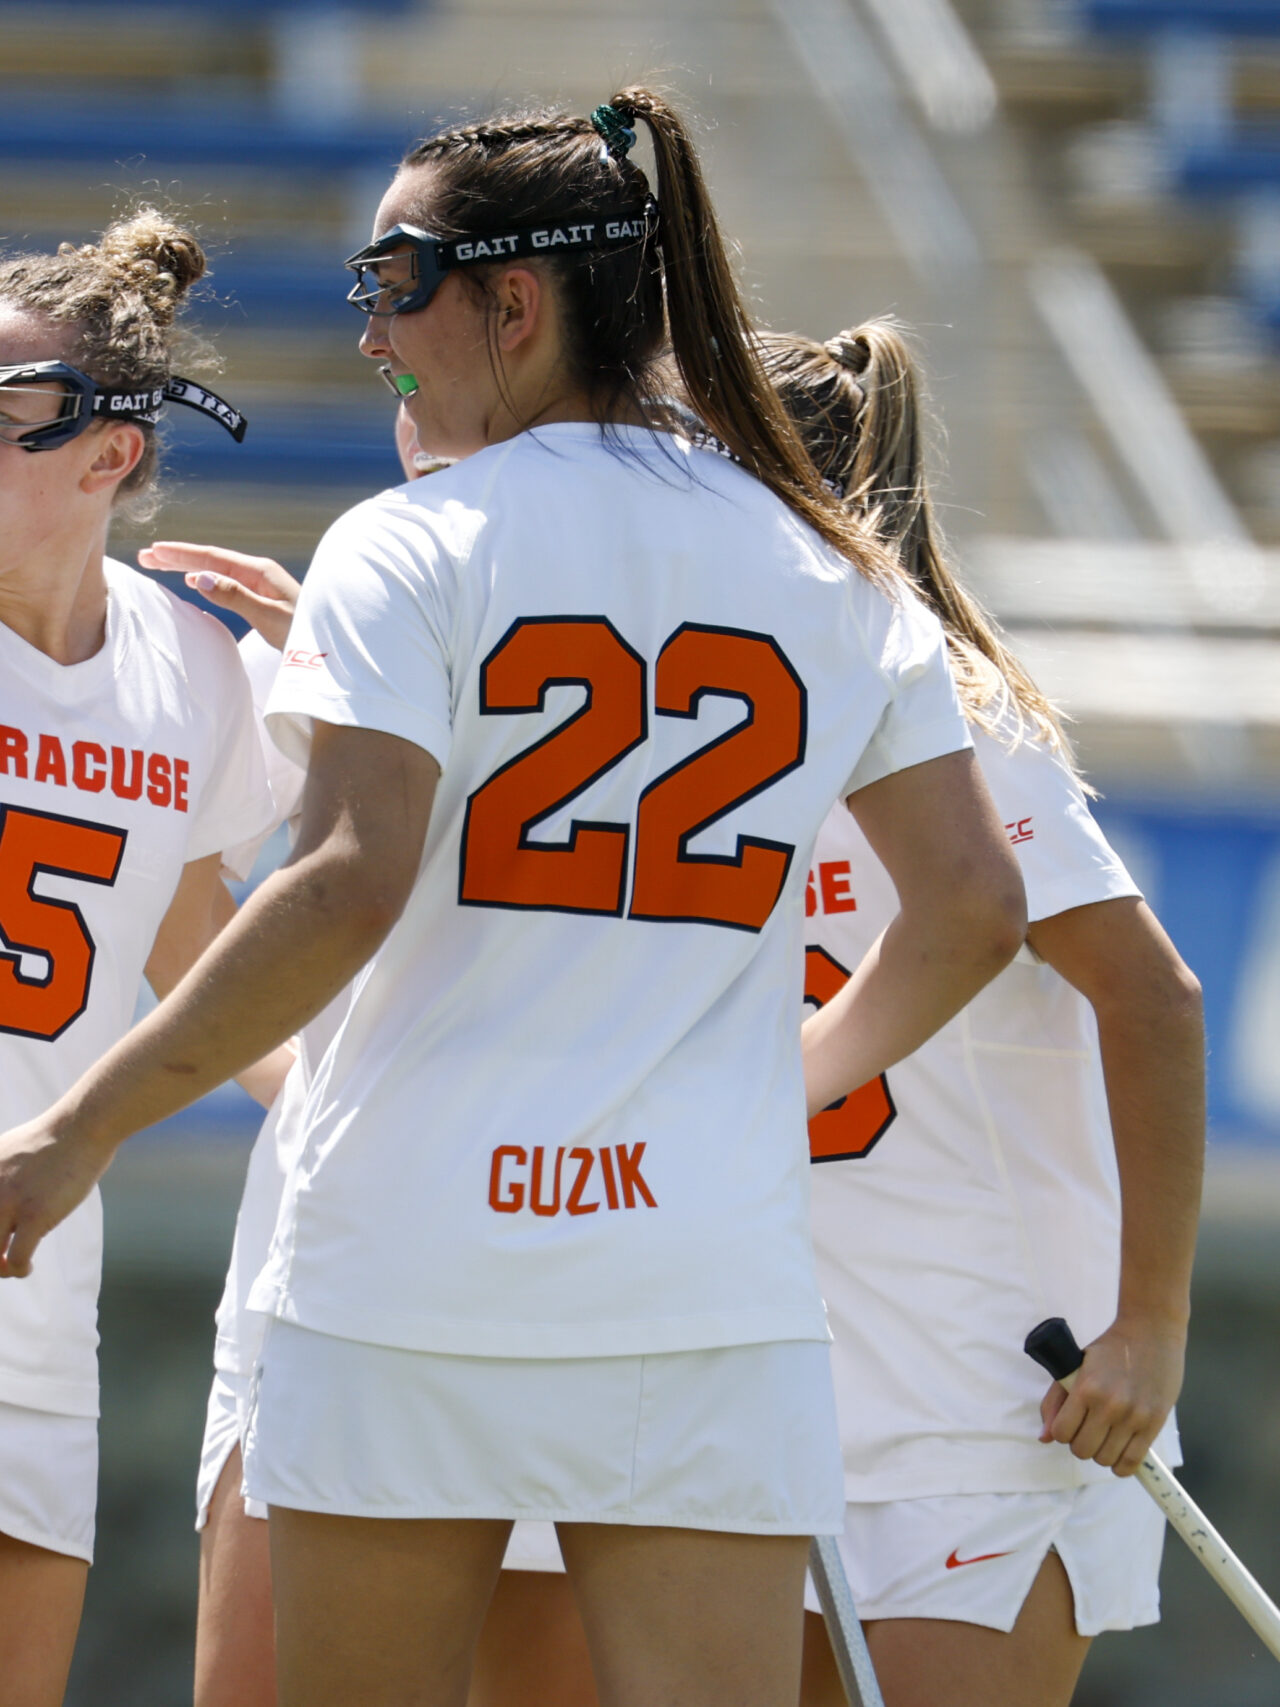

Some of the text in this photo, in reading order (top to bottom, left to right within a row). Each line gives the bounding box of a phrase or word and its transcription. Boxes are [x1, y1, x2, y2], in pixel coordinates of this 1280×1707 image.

[455, 235, 519, 261] GAIT
[531, 225, 595, 248] GAIT
[110, 393, 149, 411] GAIT
[457, 614, 808, 934] 22
[488, 1141, 658, 1217] GUZIK
